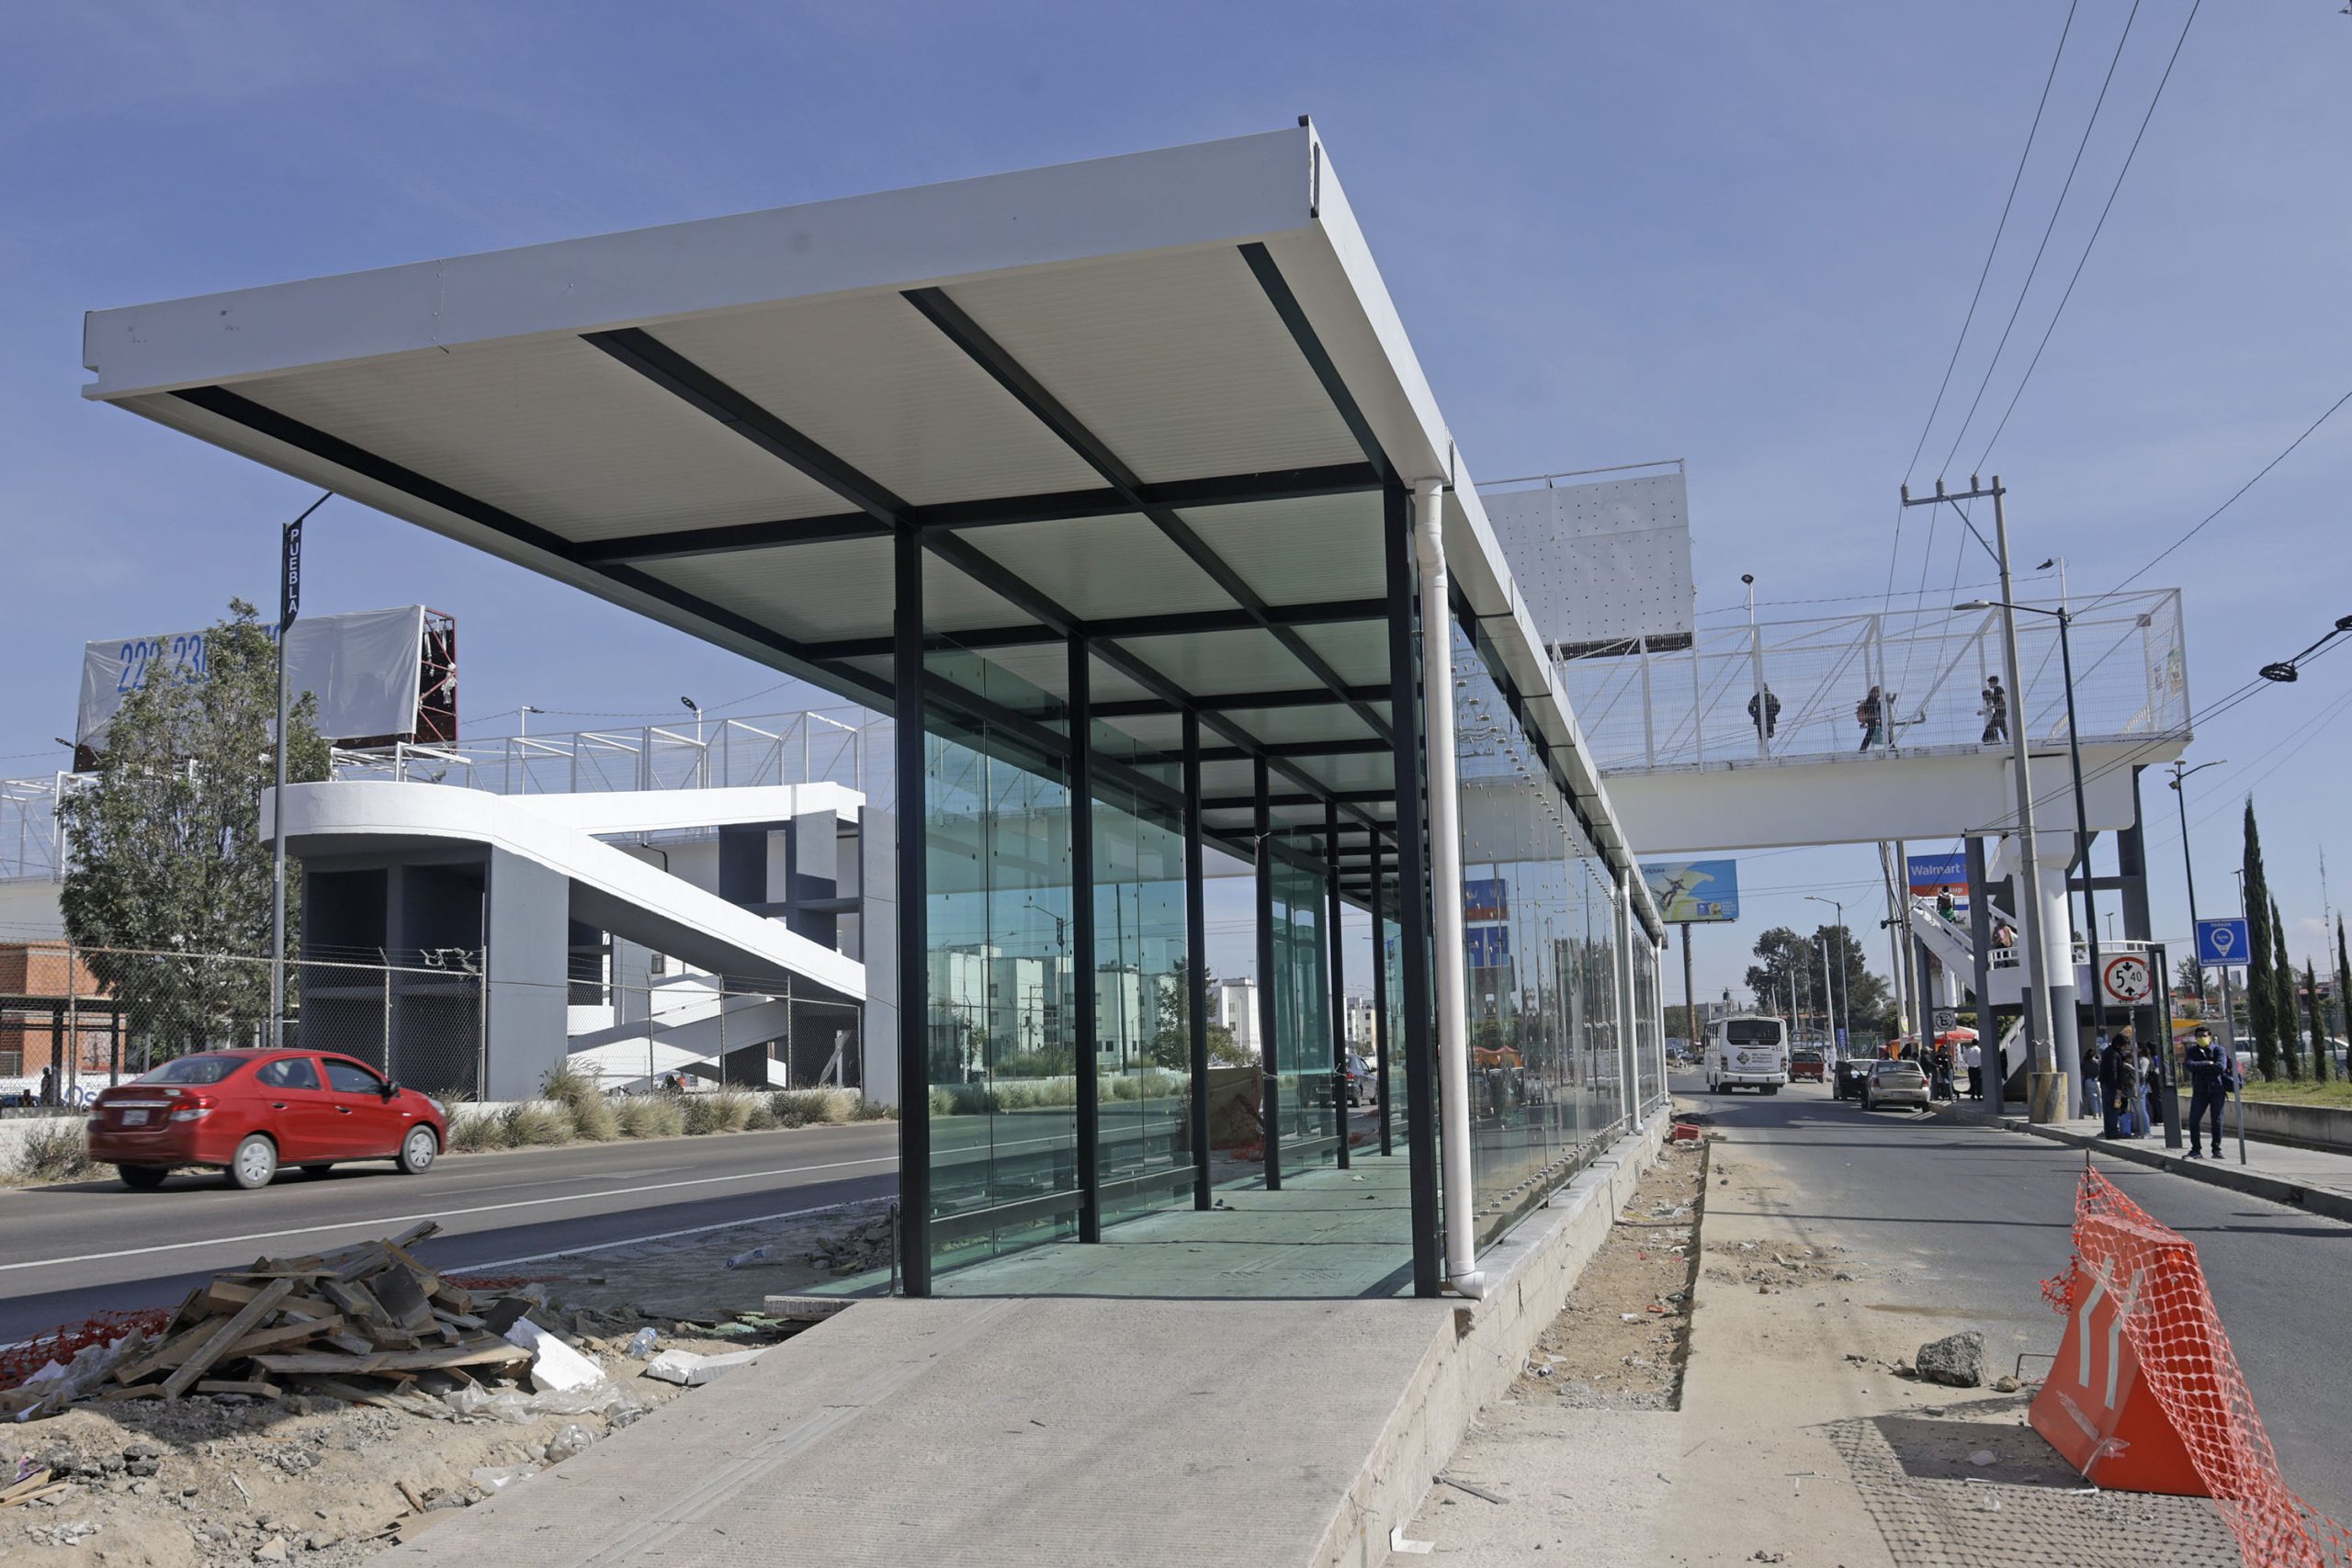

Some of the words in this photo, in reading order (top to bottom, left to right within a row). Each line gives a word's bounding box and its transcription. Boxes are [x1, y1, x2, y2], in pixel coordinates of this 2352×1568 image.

[288, 528, 300, 614] PUEBLA
[1911, 863, 1962, 876] Walmart
[2116, 970, 2125, 988] 5
[2131, 971, 2143, 982] 40
